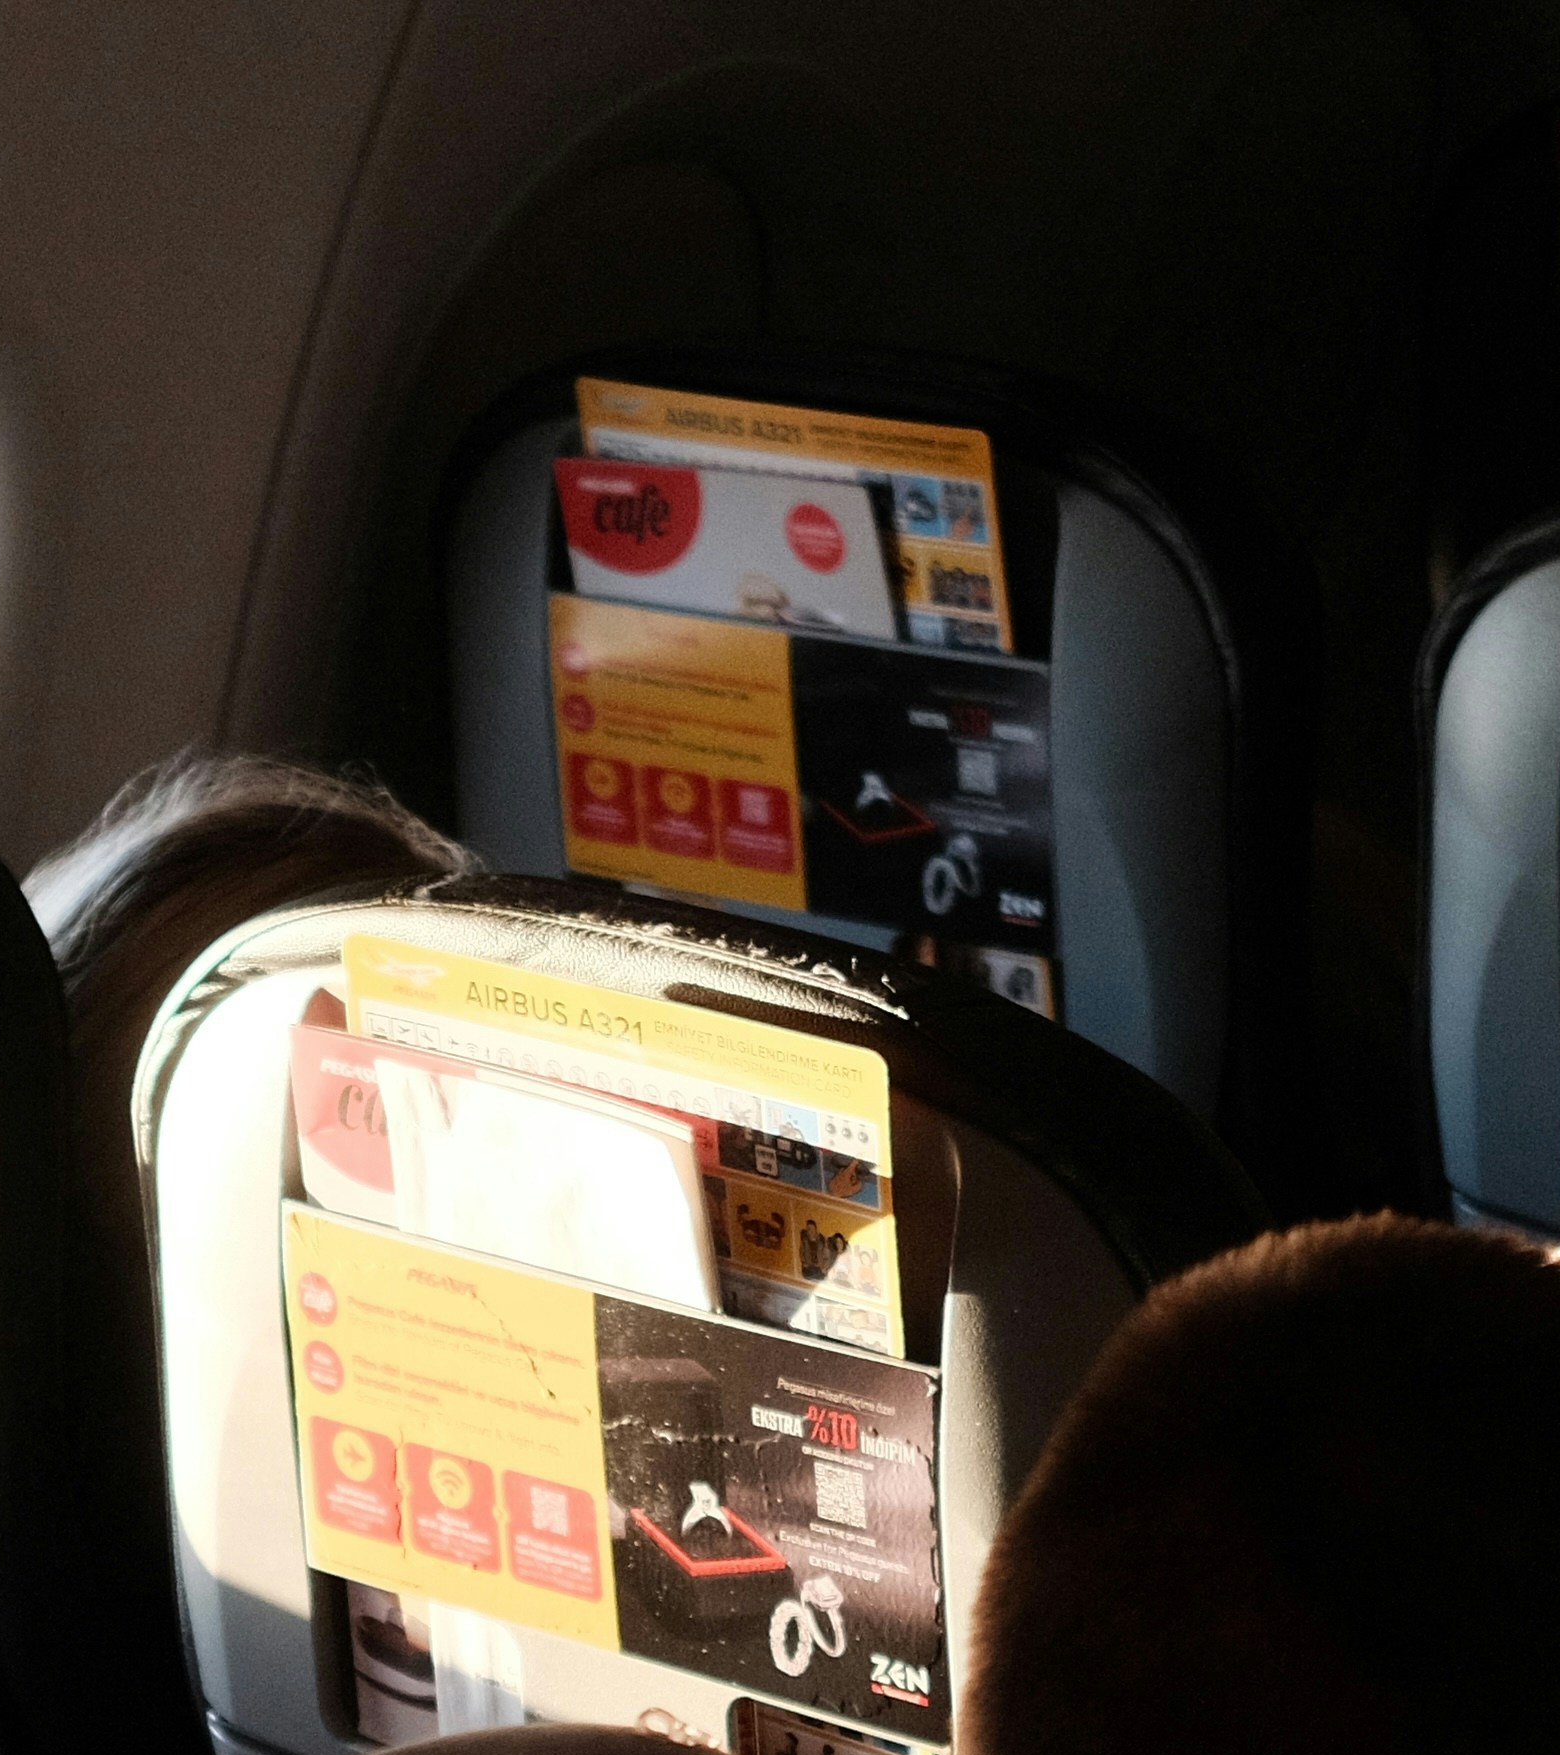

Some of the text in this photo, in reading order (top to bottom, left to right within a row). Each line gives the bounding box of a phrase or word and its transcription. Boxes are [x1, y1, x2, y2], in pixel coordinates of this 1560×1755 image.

[466, 981, 645, 1047] AIRBUS A321
[750, 1404, 804, 1440] EKSTRA
[806, 1402, 858, 1453] %10
[870, 1652, 930, 1695] ZEN
